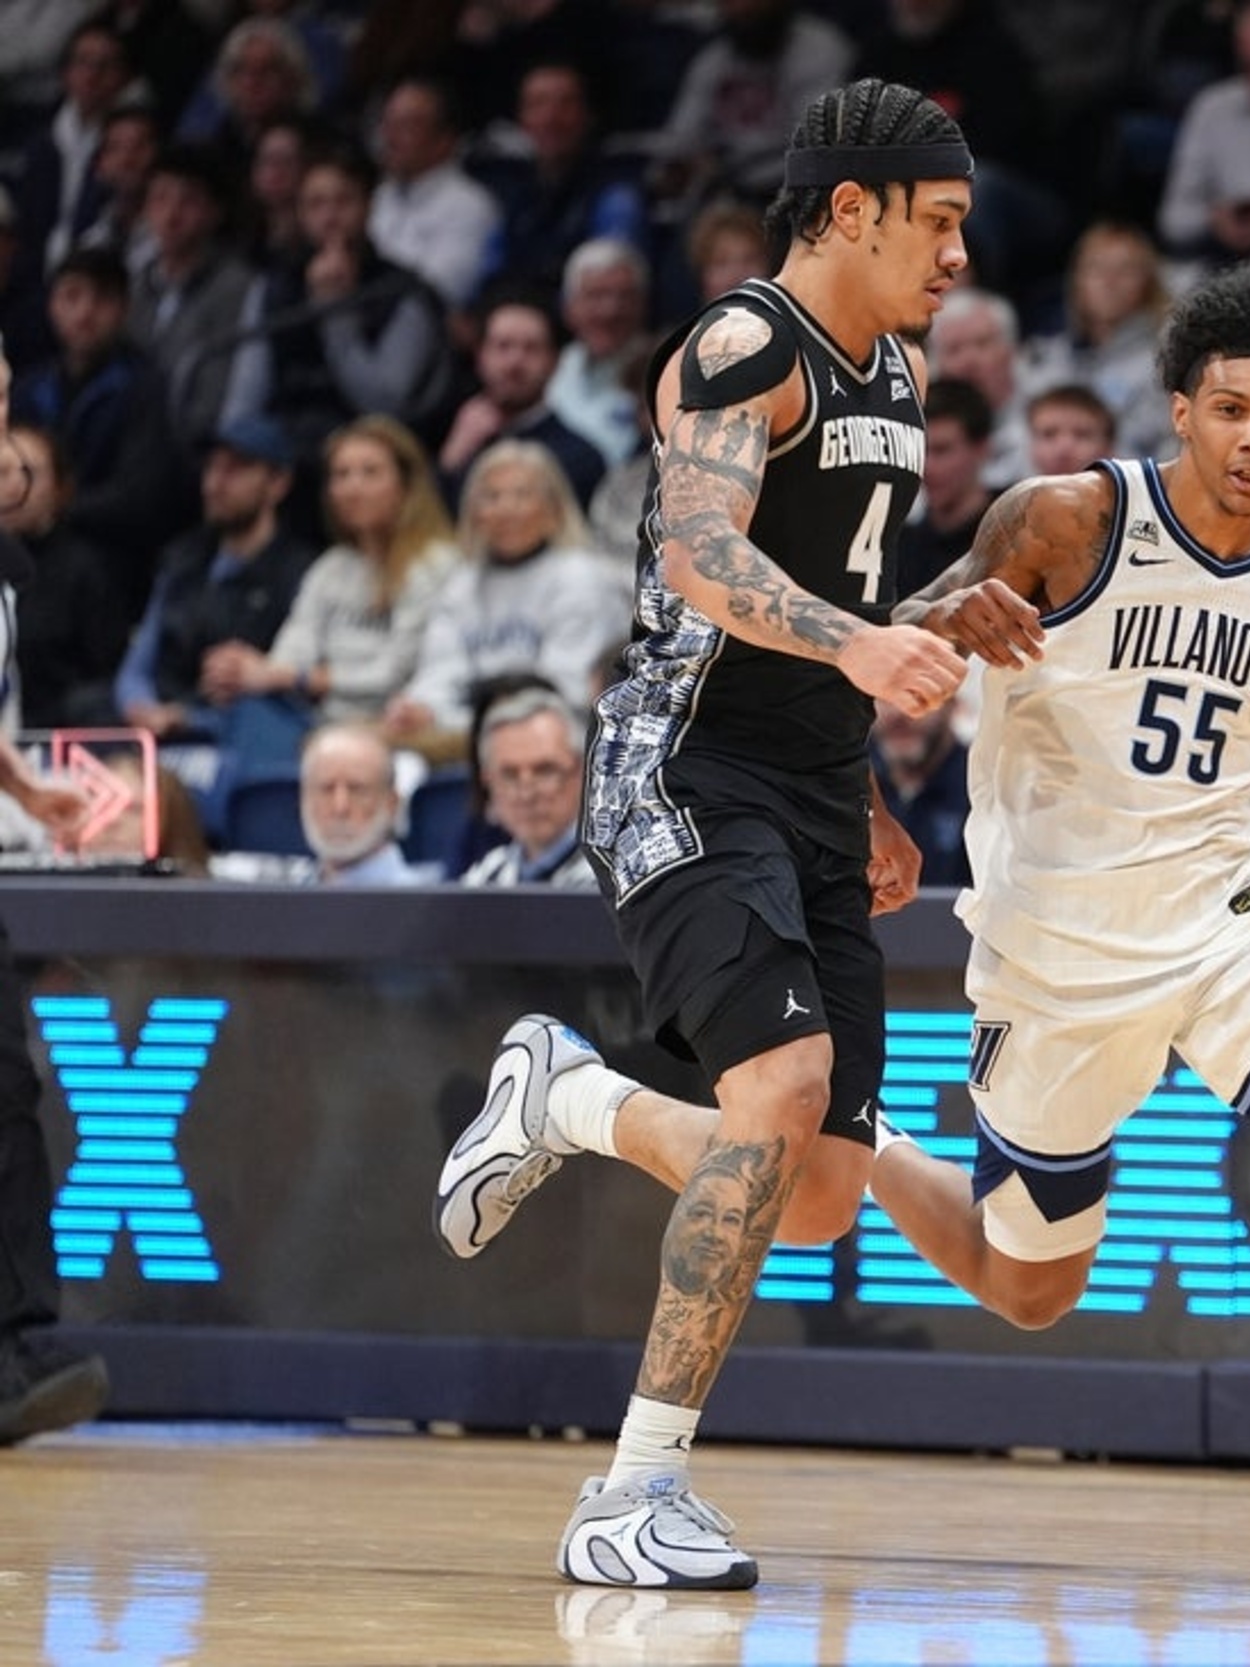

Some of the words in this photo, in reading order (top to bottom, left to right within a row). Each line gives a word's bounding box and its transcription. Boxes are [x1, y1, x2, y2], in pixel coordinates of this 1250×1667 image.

[845, 481, 893, 604] 4
[1130, 677, 1244, 786] 55
[31, 996, 229, 1283] X
